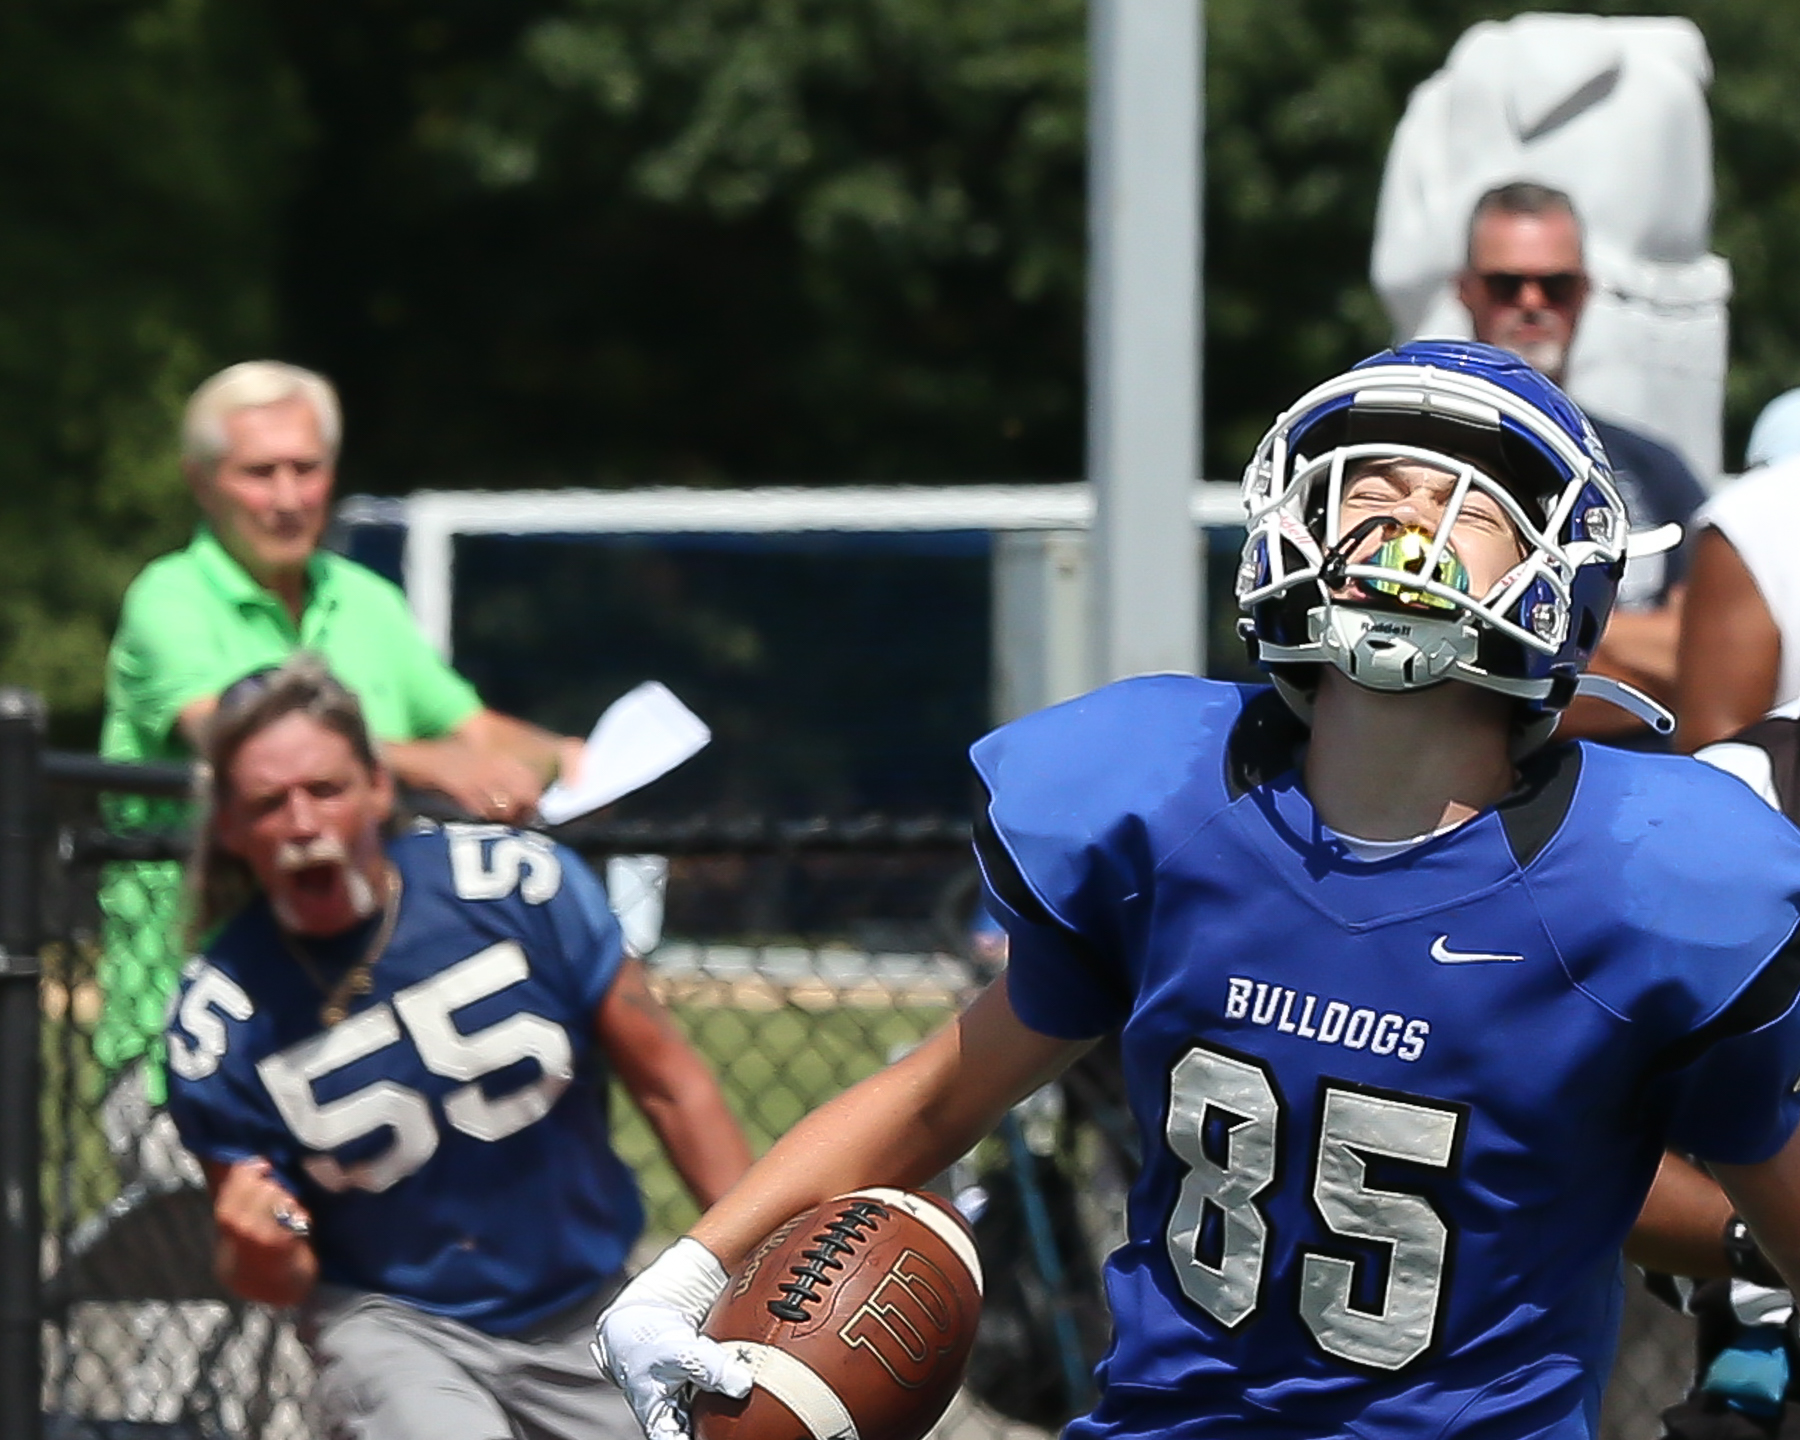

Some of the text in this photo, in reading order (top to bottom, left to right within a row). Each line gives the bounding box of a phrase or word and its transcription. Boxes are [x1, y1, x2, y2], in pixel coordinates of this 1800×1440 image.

[256, 938, 573, 1193] 55
[1225, 976, 1430, 1062] BULLDOGS
[1164, 1044, 1463, 1373] 85
